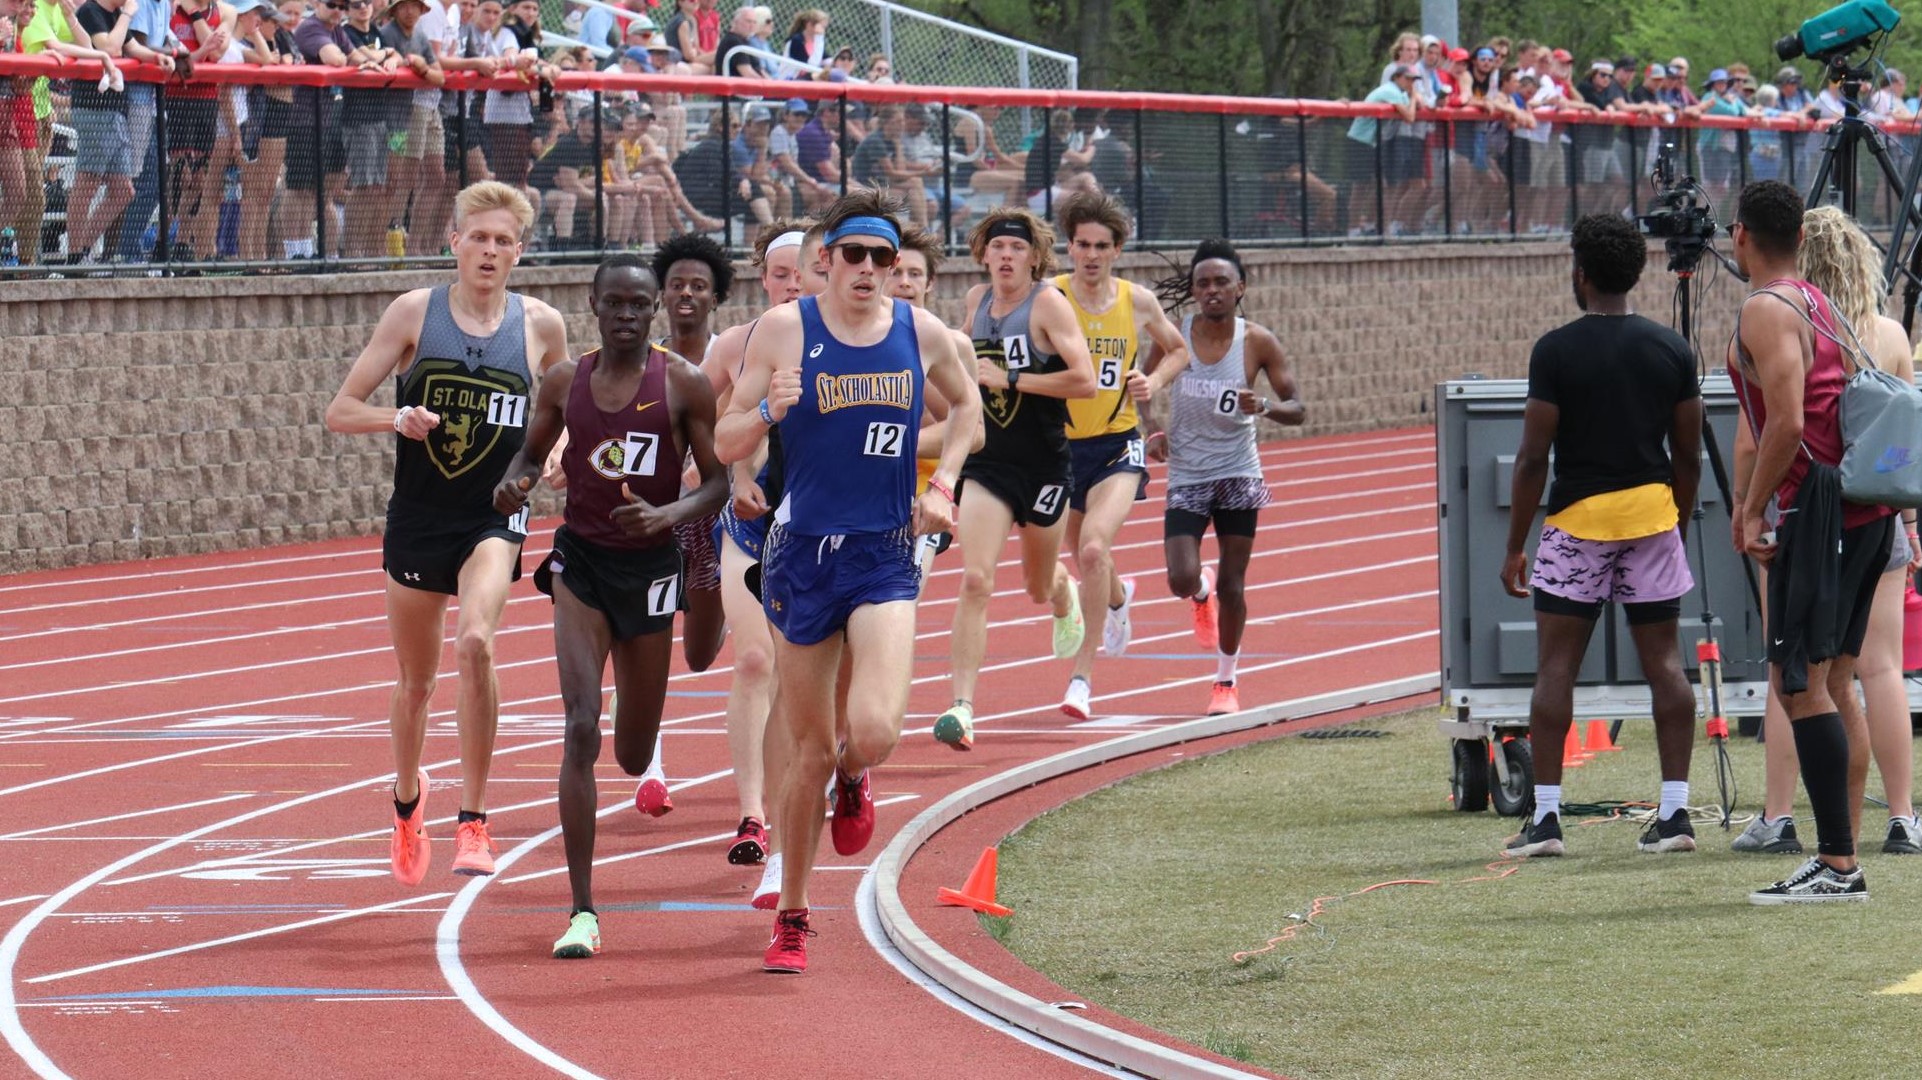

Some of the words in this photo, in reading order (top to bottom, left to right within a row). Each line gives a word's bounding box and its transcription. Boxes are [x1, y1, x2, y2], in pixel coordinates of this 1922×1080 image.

[1009, 338, 1025, 365] 4
[1087, 337, 1128, 359] LETON
[1101, 361, 1116, 387] 5
[432, 387, 454, 406] ST.
[457, 389, 488, 412] OLA
[818, 373, 838, 411] ST.
[838, 371, 912, 409] SCHOLASTICA
[1219, 389, 1237, 413] 6
[493, 395, 518, 425] 11
[870, 424, 899, 455] 12
[1131, 440, 1142, 465] 5
[630, 435, 653, 472] 7
[1039, 487, 1059, 511] 4
[654, 578, 674, 612] 7
